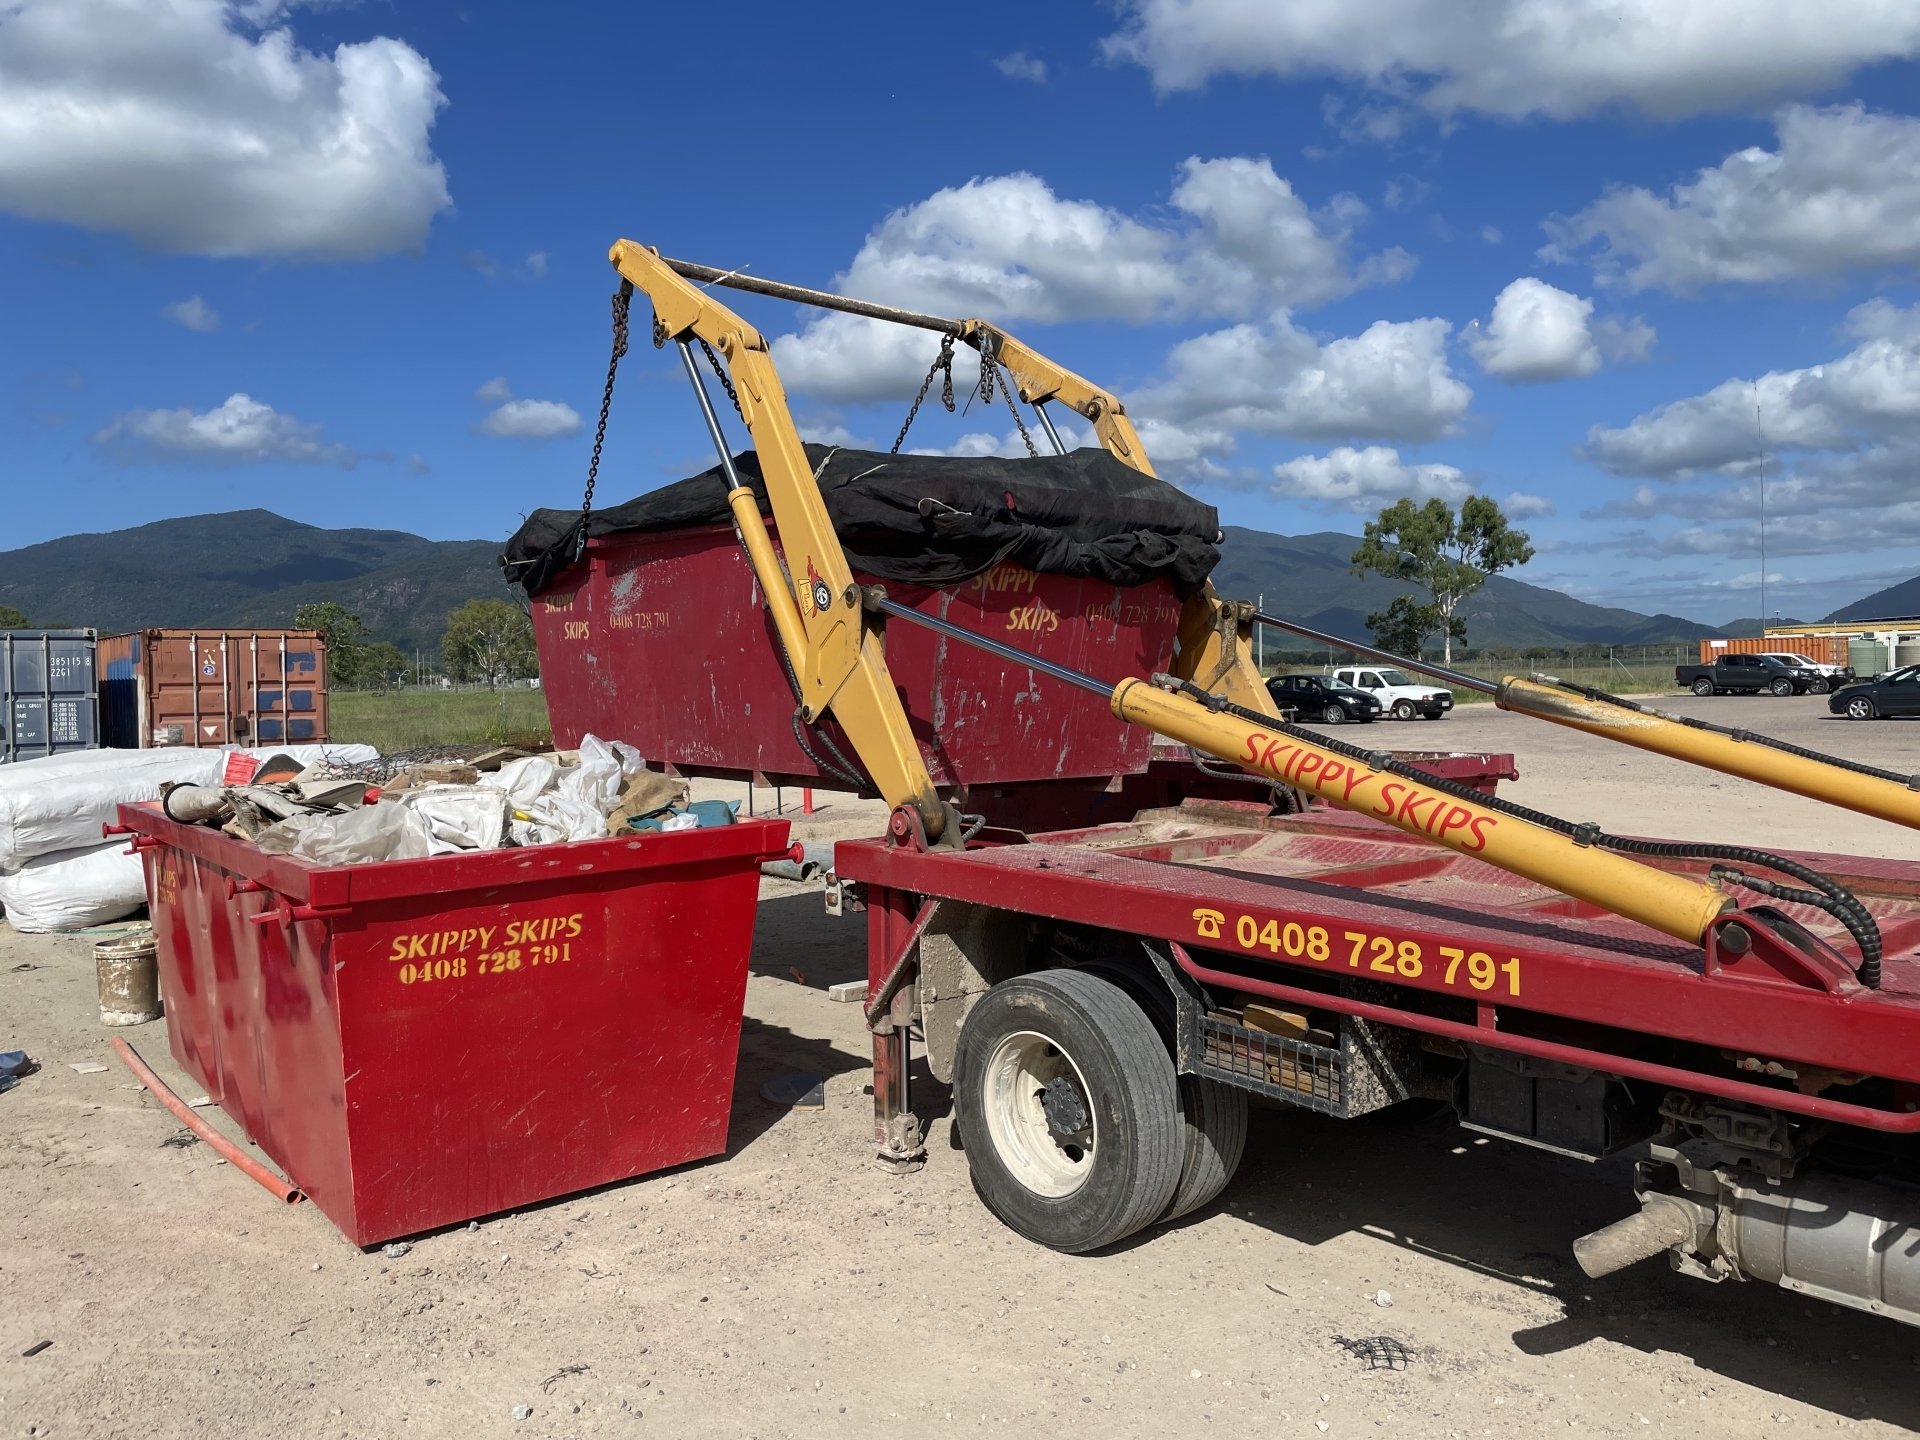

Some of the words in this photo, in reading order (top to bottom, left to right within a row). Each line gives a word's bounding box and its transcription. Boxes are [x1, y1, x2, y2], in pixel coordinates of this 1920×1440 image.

[971, 568, 1040, 593] SKIPPY
[544, 593, 575, 614] SKIPPY
[1126, 605, 1149, 624] 728
[564, 620, 590, 641] SKIPS
[609, 613, 633, 629] 0408
[635, 613, 652, 629] 728
[654, 612, 670, 628] 791
[1006, 606, 1061, 632] SKIPS
[50, 657, 81, 666] 385115
[50, 668, 70, 677] 22G1
[1239, 732, 1374, 801] SKIPPY
[1373, 782, 1498, 852] SKIPS
[389, 925, 498, 961] SKIPPY
[503, 913, 584, 946] SKIPS
[400, 957, 467, 985] 0408
[477, 949, 521, 975] 728
[529, 943, 571, 967] 791
[1236, 915, 1331, 962] 0408
[1344, 931, 1423, 979] 728
[1439, 946, 1521, 997] 791
